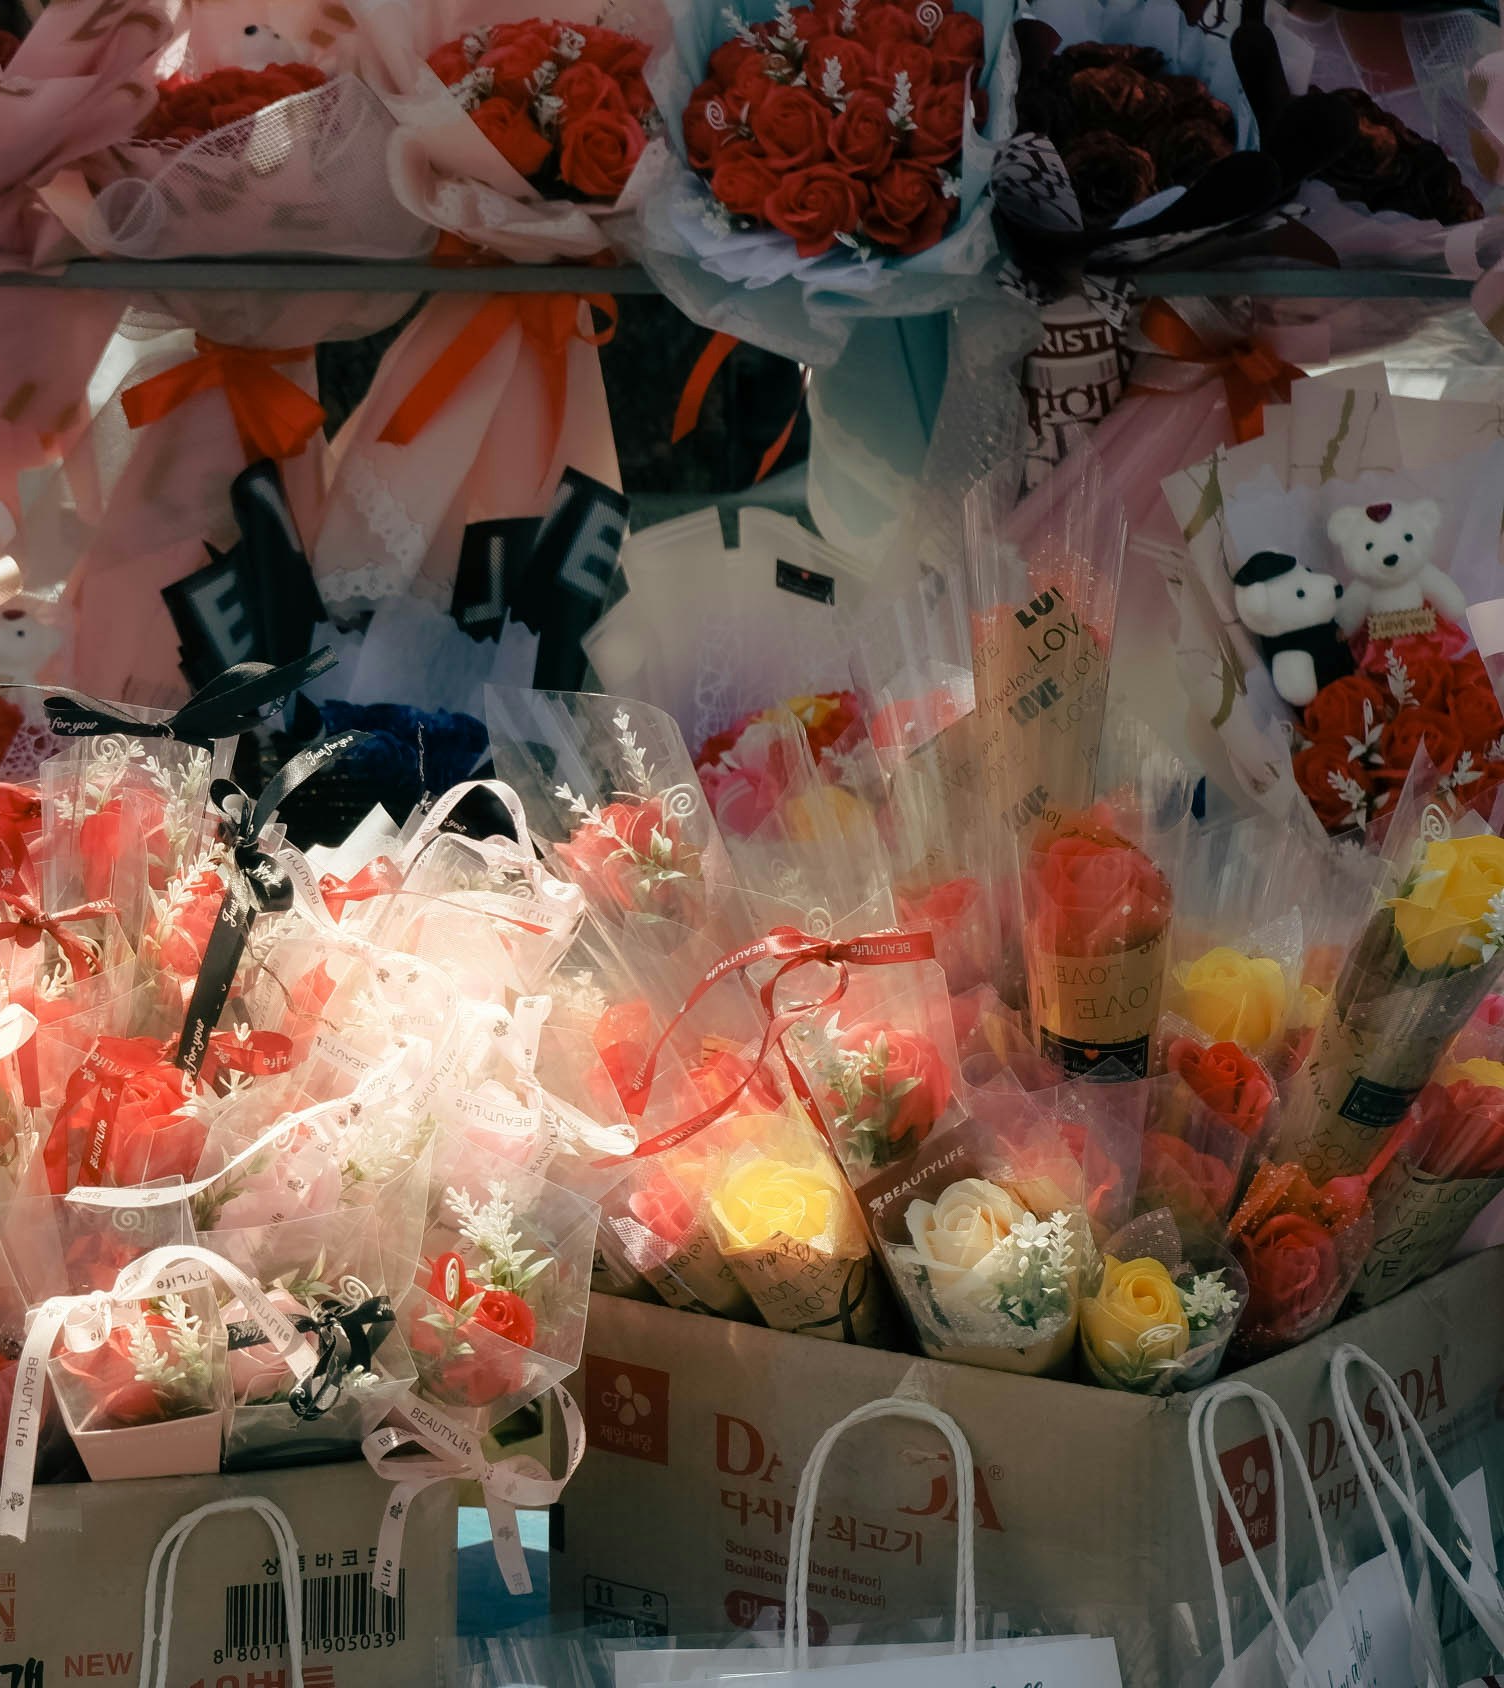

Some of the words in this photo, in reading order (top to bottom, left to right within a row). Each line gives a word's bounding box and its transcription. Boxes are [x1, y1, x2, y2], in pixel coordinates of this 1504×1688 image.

[1007, 677, 1064, 727] LOVE
[705, 943, 767, 981] BEAUTYLife
[851, 941, 912, 955] BEAUTYLife
[455, 1097, 535, 1128] BEAUTYLife
[88, 1118, 108, 1170] BEAUTYLife
[883, 1144, 966, 1206] BEAUTYLIFE
[15, 1355, 40, 1448] BEAUTYLife
[410, 1407, 473, 1456] BEAUTYLife
[724, 1539, 762, 1562] Soup
[843, 1567, 882, 1592] flavor)
[826, 1515, 924, 1568] 쇠고기
[724, 1559, 784, 1586] Bouillon
[831, 1584, 847, 1600] de
[64, 1651, 135, 1678] NEW
[213, 1649, 225, 1665] 8
[237, 1639, 310, 1663] 80111
[322, 1631, 396, 1654] 905039
